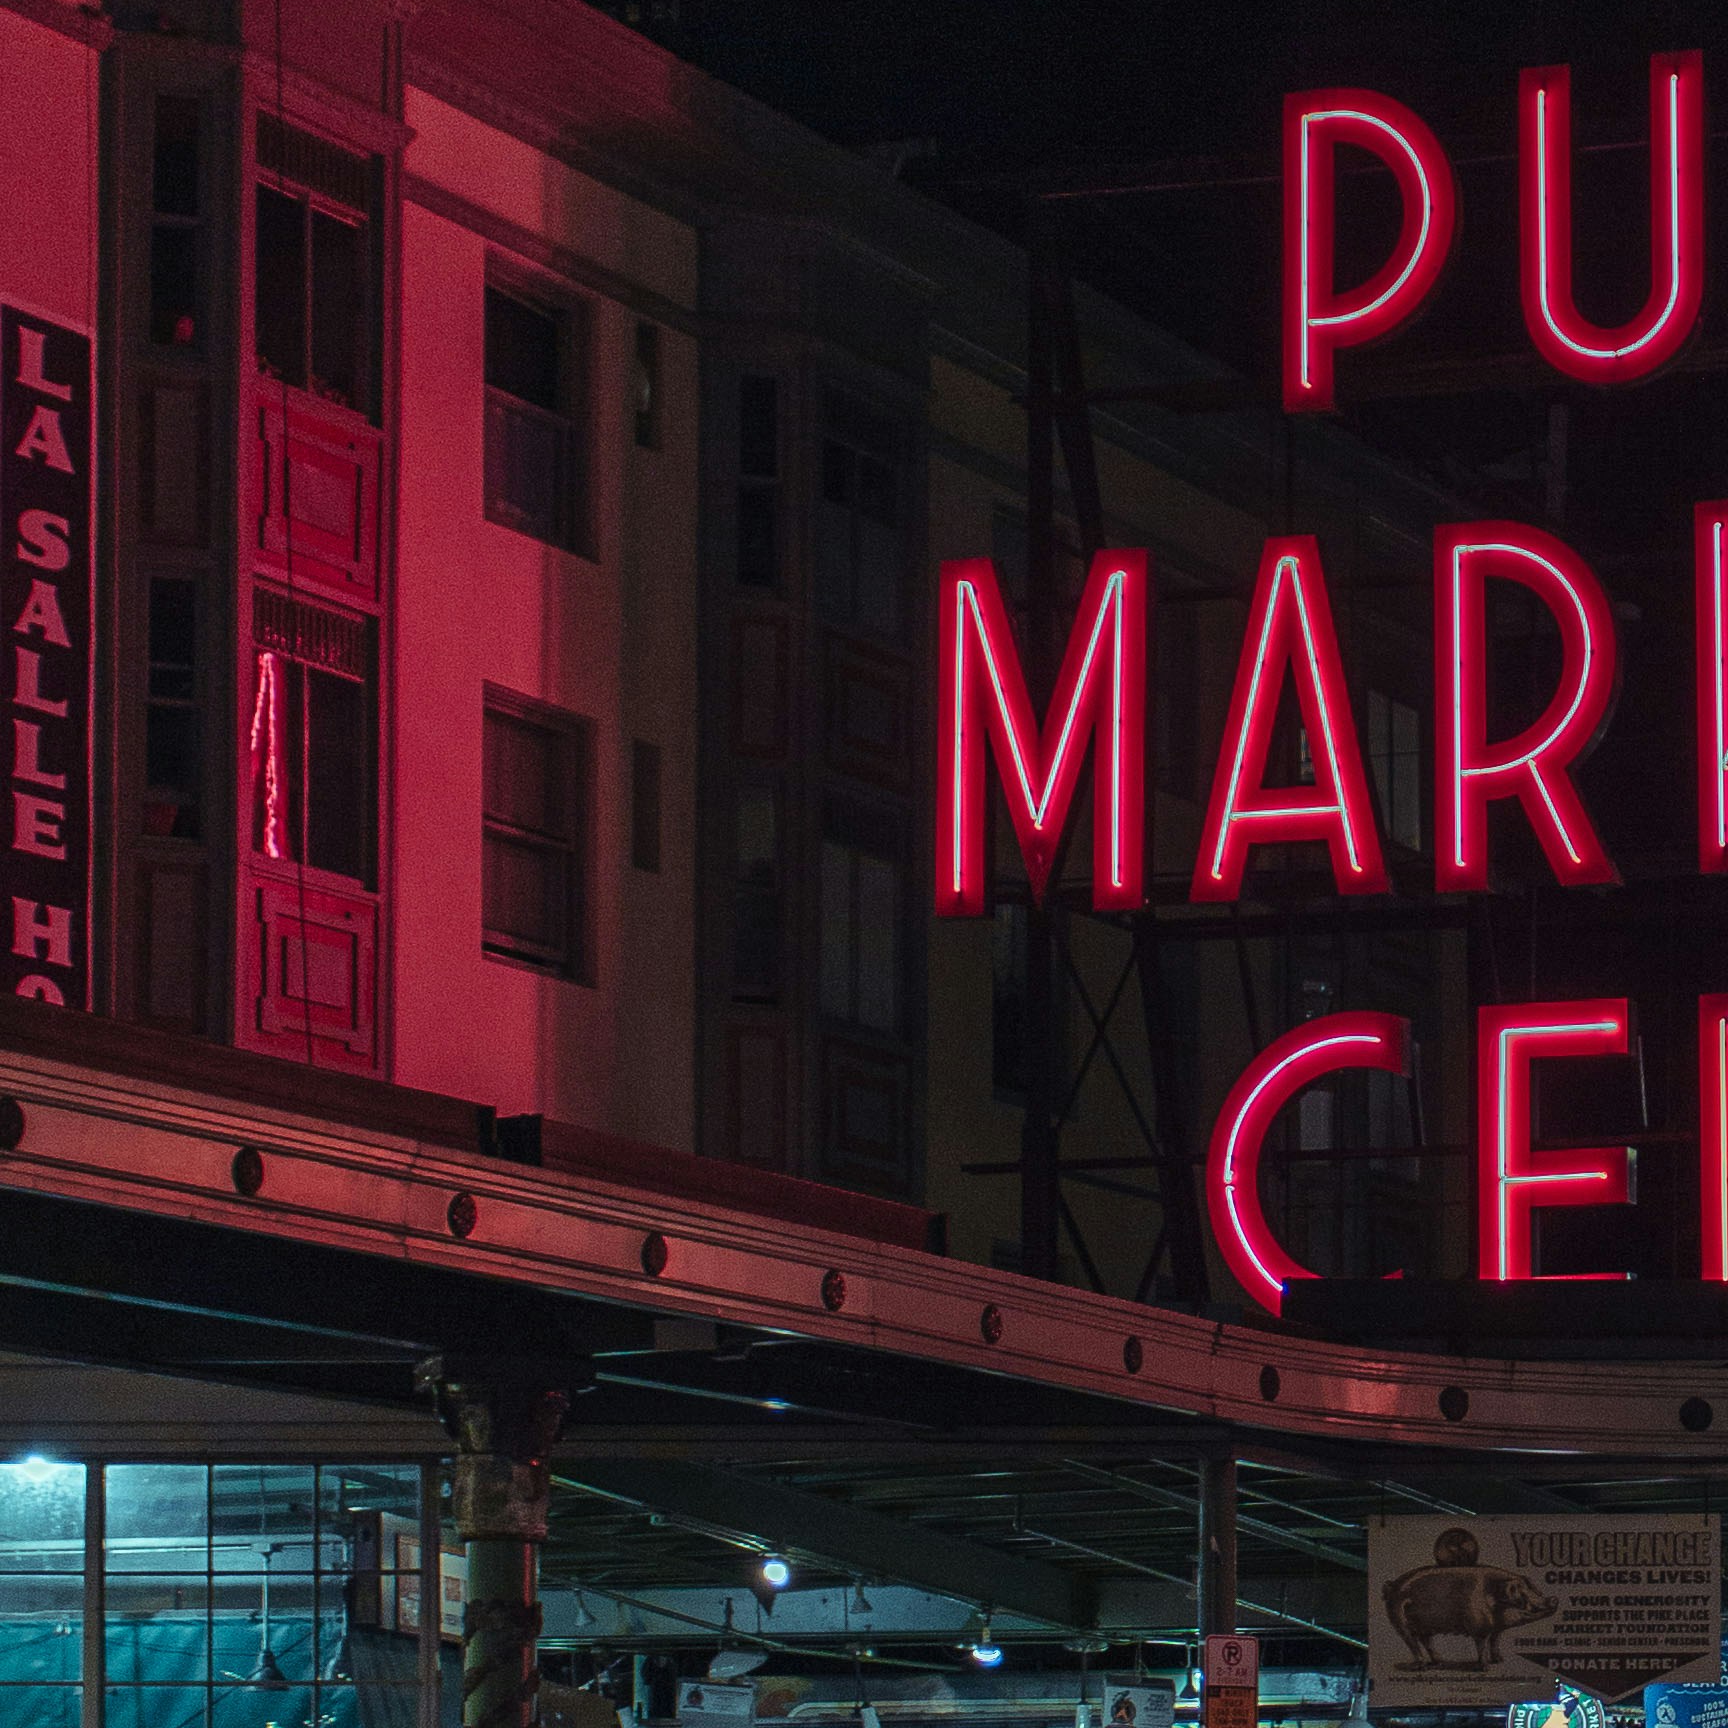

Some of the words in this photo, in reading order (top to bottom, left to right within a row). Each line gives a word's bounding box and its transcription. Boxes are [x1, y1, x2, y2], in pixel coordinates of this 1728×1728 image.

[15, 324, 75, 474] LA
[11, 507, 73, 862] SALLE
[1510, 1531, 1591, 1568] YOUR
[1593, 1531, 1713, 1568] CHANGE
[1544, 1570, 1642, 1585] CHANGES
[1646, 1570, 1712, 1584] LIVES!
[1569, 1595, 1611, 1607] YOUR
[1613, 1595, 1710, 1607] GENEROSITY
[1562, 1609, 1621, 1622] SUPPORTS
[1623, 1609, 1645, 1622] THE
[1648, 1609, 1673, 1622] PIKE
[1675, 1609, 1710, 1622] PLACE
[1553, 1623, 1614, 1635] MARKET
[1616, 1623, 1710, 1635] FOUNDATION
[1549, 1658, 1623, 1671] DONATE
[1625, 1657, 1678, 1671] HERE!
